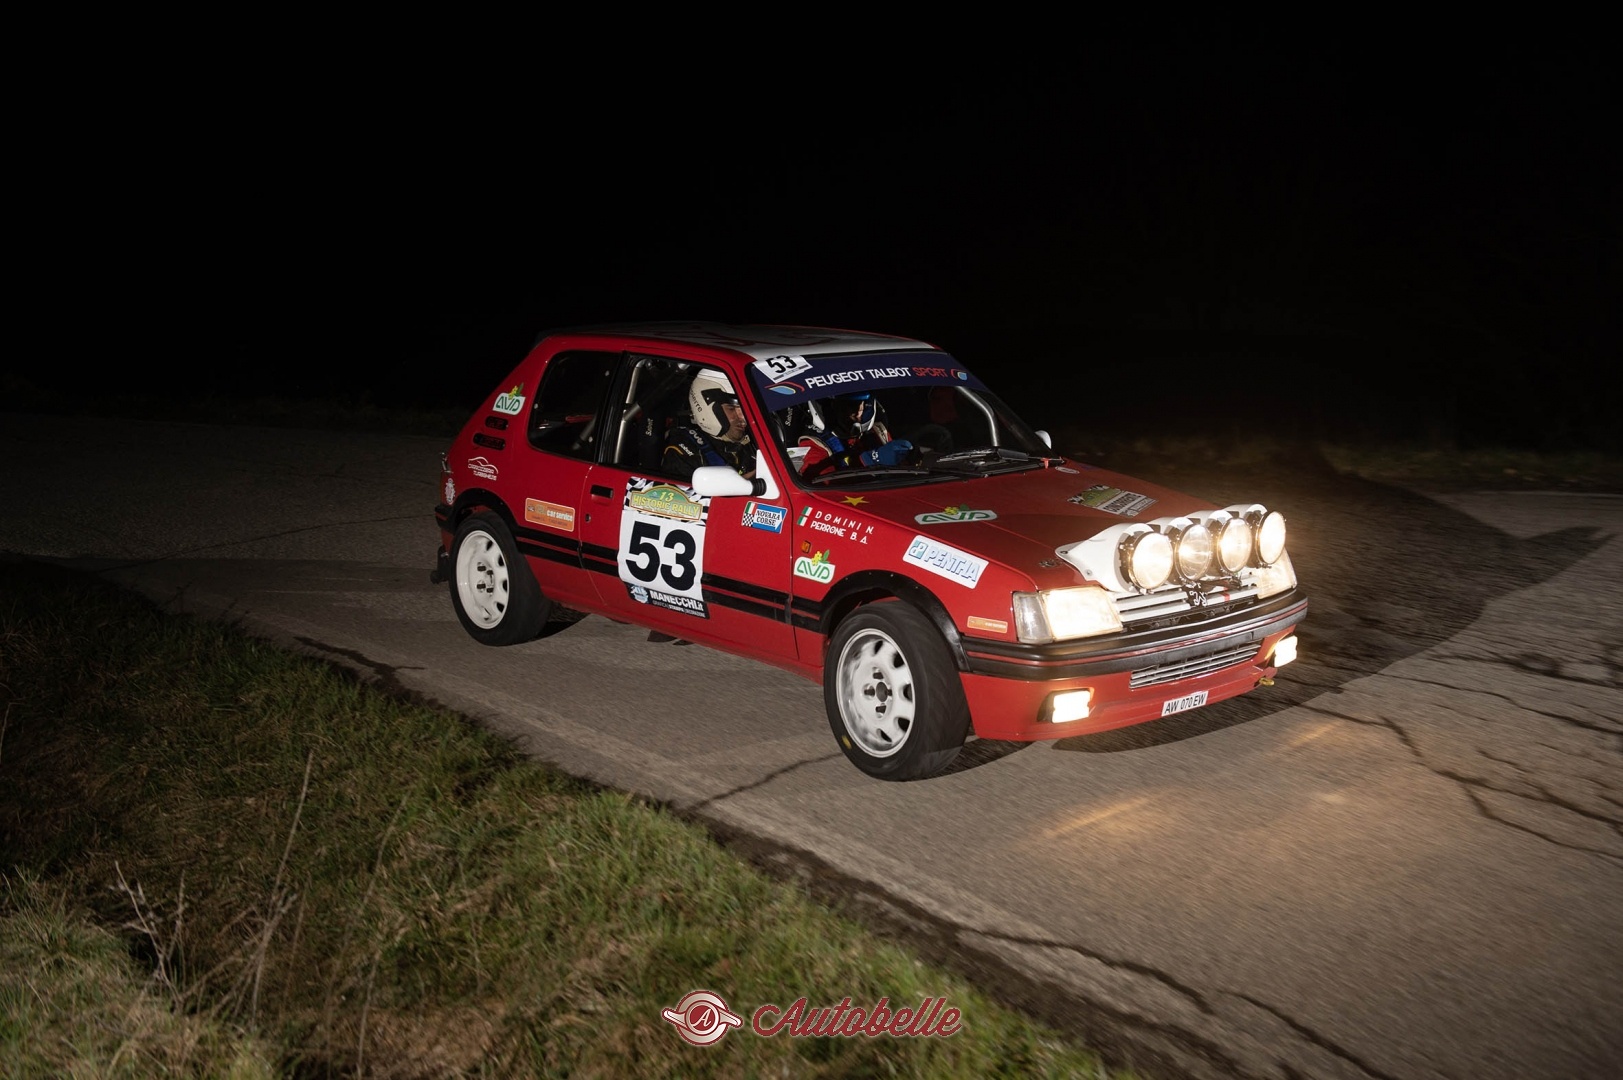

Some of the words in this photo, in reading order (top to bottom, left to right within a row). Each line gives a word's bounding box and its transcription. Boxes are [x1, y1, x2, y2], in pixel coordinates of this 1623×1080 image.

[766, 355, 797, 373] 53
[804, 370, 866, 389] PEUGEOT
[866, 367, 912, 380] TALBOT
[912, 366, 948, 378] SPORT
[660, 491, 675, 502] 13
[632, 494, 671, 510] HISTORIC
[671, 504, 699, 518] RALLY
[556, 511, 573, 522] service
[756, 510, 781, 521] NOVARA
[756, 517, 777, 527] CORSE
[810, 520, 847, 537] PERRONE
[625, 520, 697, 592] 53
[1164, 700, 1180, 715] AW
[1180, 696, 1194, 710] 070
[1193, 692, 1207, 707] EW
